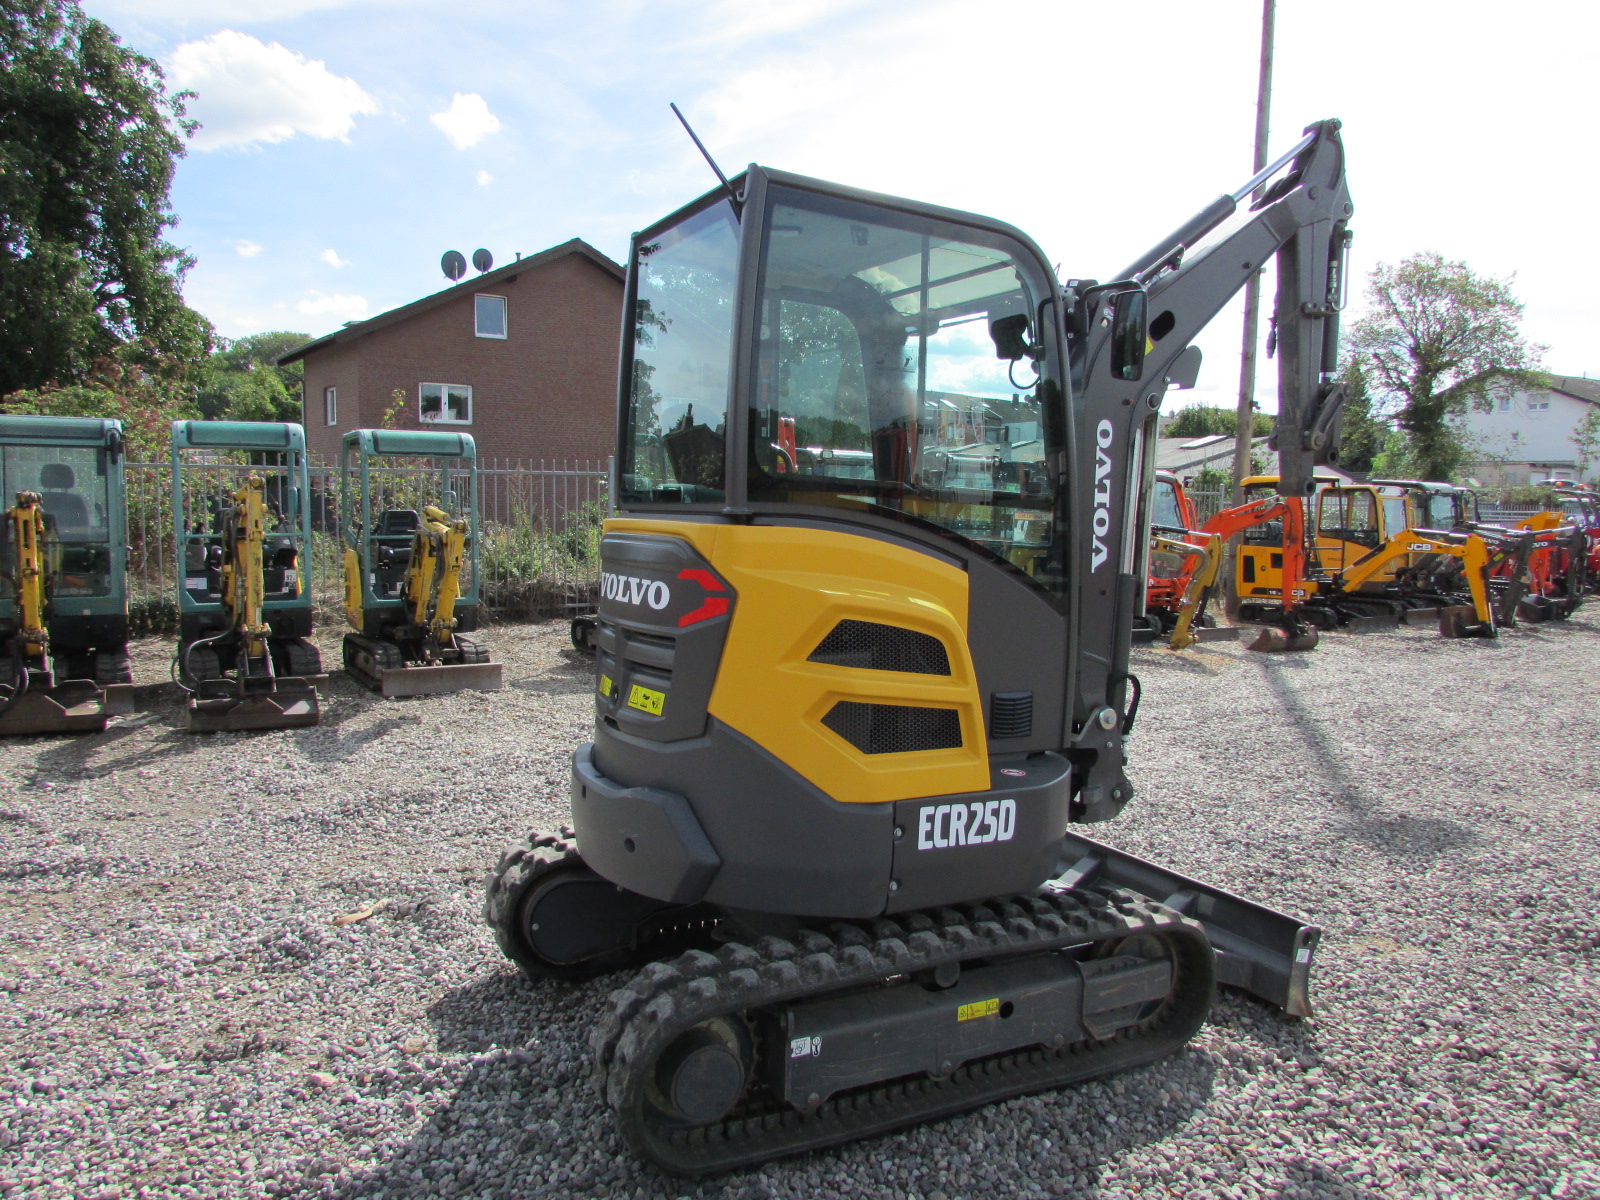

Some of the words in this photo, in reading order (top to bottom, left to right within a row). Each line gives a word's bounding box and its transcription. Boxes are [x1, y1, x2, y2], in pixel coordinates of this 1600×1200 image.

[1091, 419, 1113, 574] VOLVO
[1406, 543, 1431, 551] JCB
[600, 572, 670, 610] VOLVO
[918, 799, 1016, 851] ECR25D
